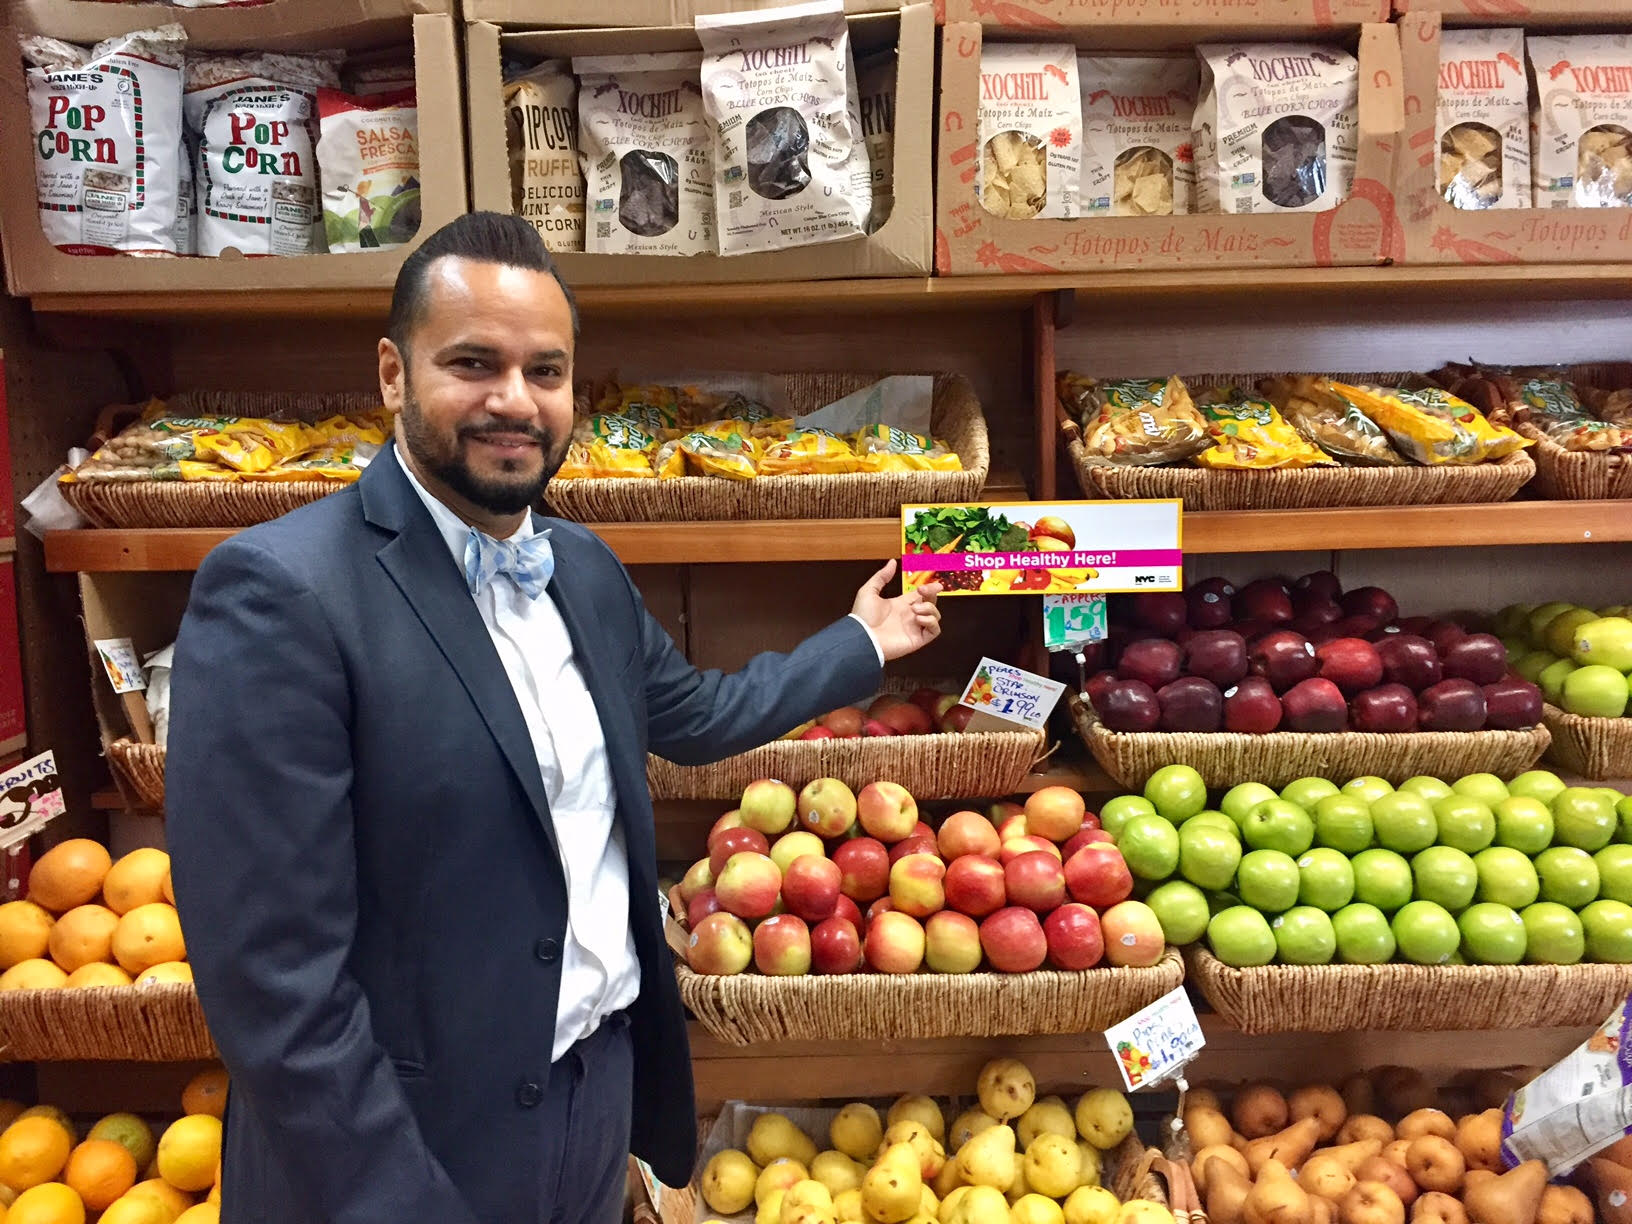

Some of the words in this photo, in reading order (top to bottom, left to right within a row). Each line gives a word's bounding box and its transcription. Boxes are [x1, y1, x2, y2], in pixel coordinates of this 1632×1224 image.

[43, 73, 104, 84] JANE'S
[233, 94, 290, 103] JANE'S
[1015, 107, 1025, 118] de
[356, 127, 414, 145] SALSA
[360, 143, 416, 160] FRESCA
[1521, 215, 1607, 251] Totopos
[1063, 227, 1149, 262] Totopos
[1159, 226, 1185, 252] de
[964, 553, 1006, 570] Shop
[1010, 552, 1071, 568] Healthy
[1074, 551, 1117, 565] Here!
